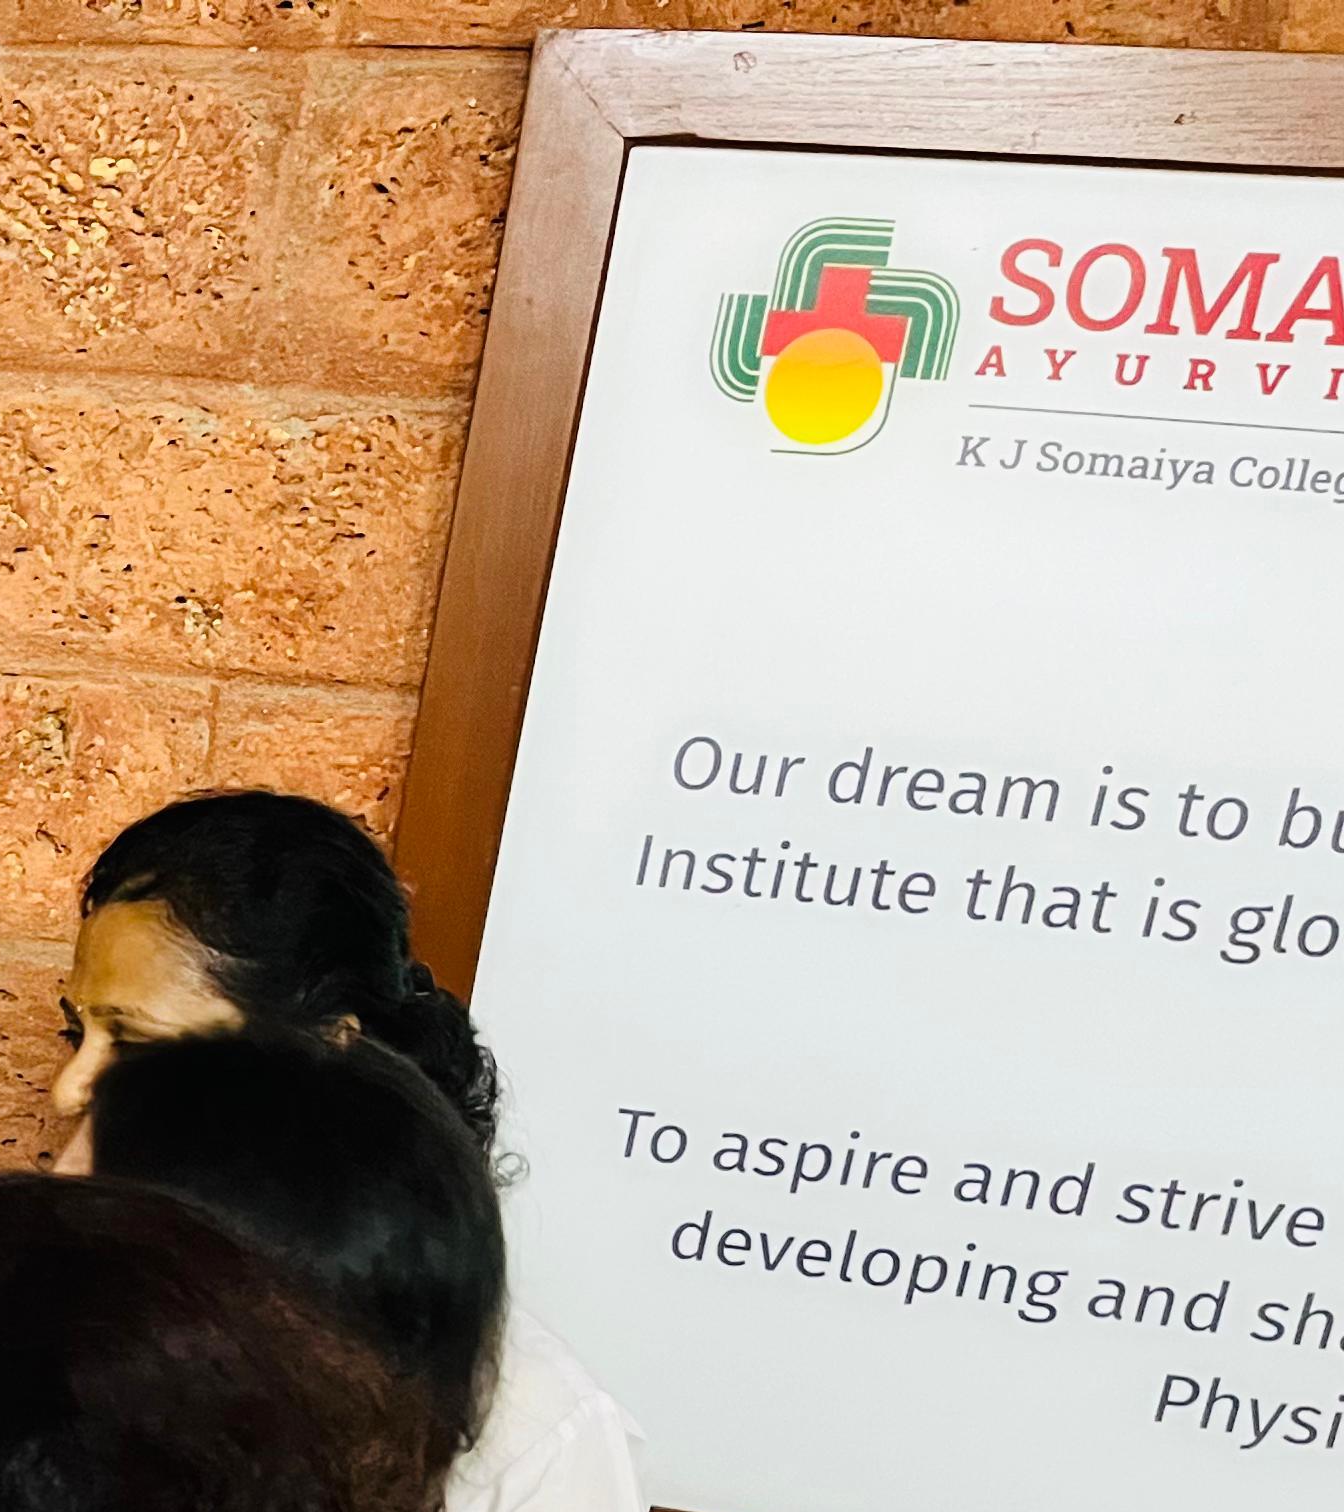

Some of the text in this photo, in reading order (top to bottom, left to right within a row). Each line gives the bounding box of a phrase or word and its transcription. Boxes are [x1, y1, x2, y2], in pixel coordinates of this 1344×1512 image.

[989, 238, 1344, 346] SOMA
[975, 345, 1344, 400] AYURVI
[956, 436, 991, 467] K
[999, 439, 1028, 470] J
[1036, 441, 1216, 490] Somaiya
[672, 735, 807, 799] Our
[827, 745, 1062, 823] dream
[1089, 765, 1148, 831] is
[1178, 783, 1249, 841] to
[635, 834, 1340, 965] Institute that is glo
[618, 1107, 1326, 1248] To aspire and strive
[671, 1210, 1344, 1351] developing and sh
[1154, 1373, 1344, 1450] Physi
